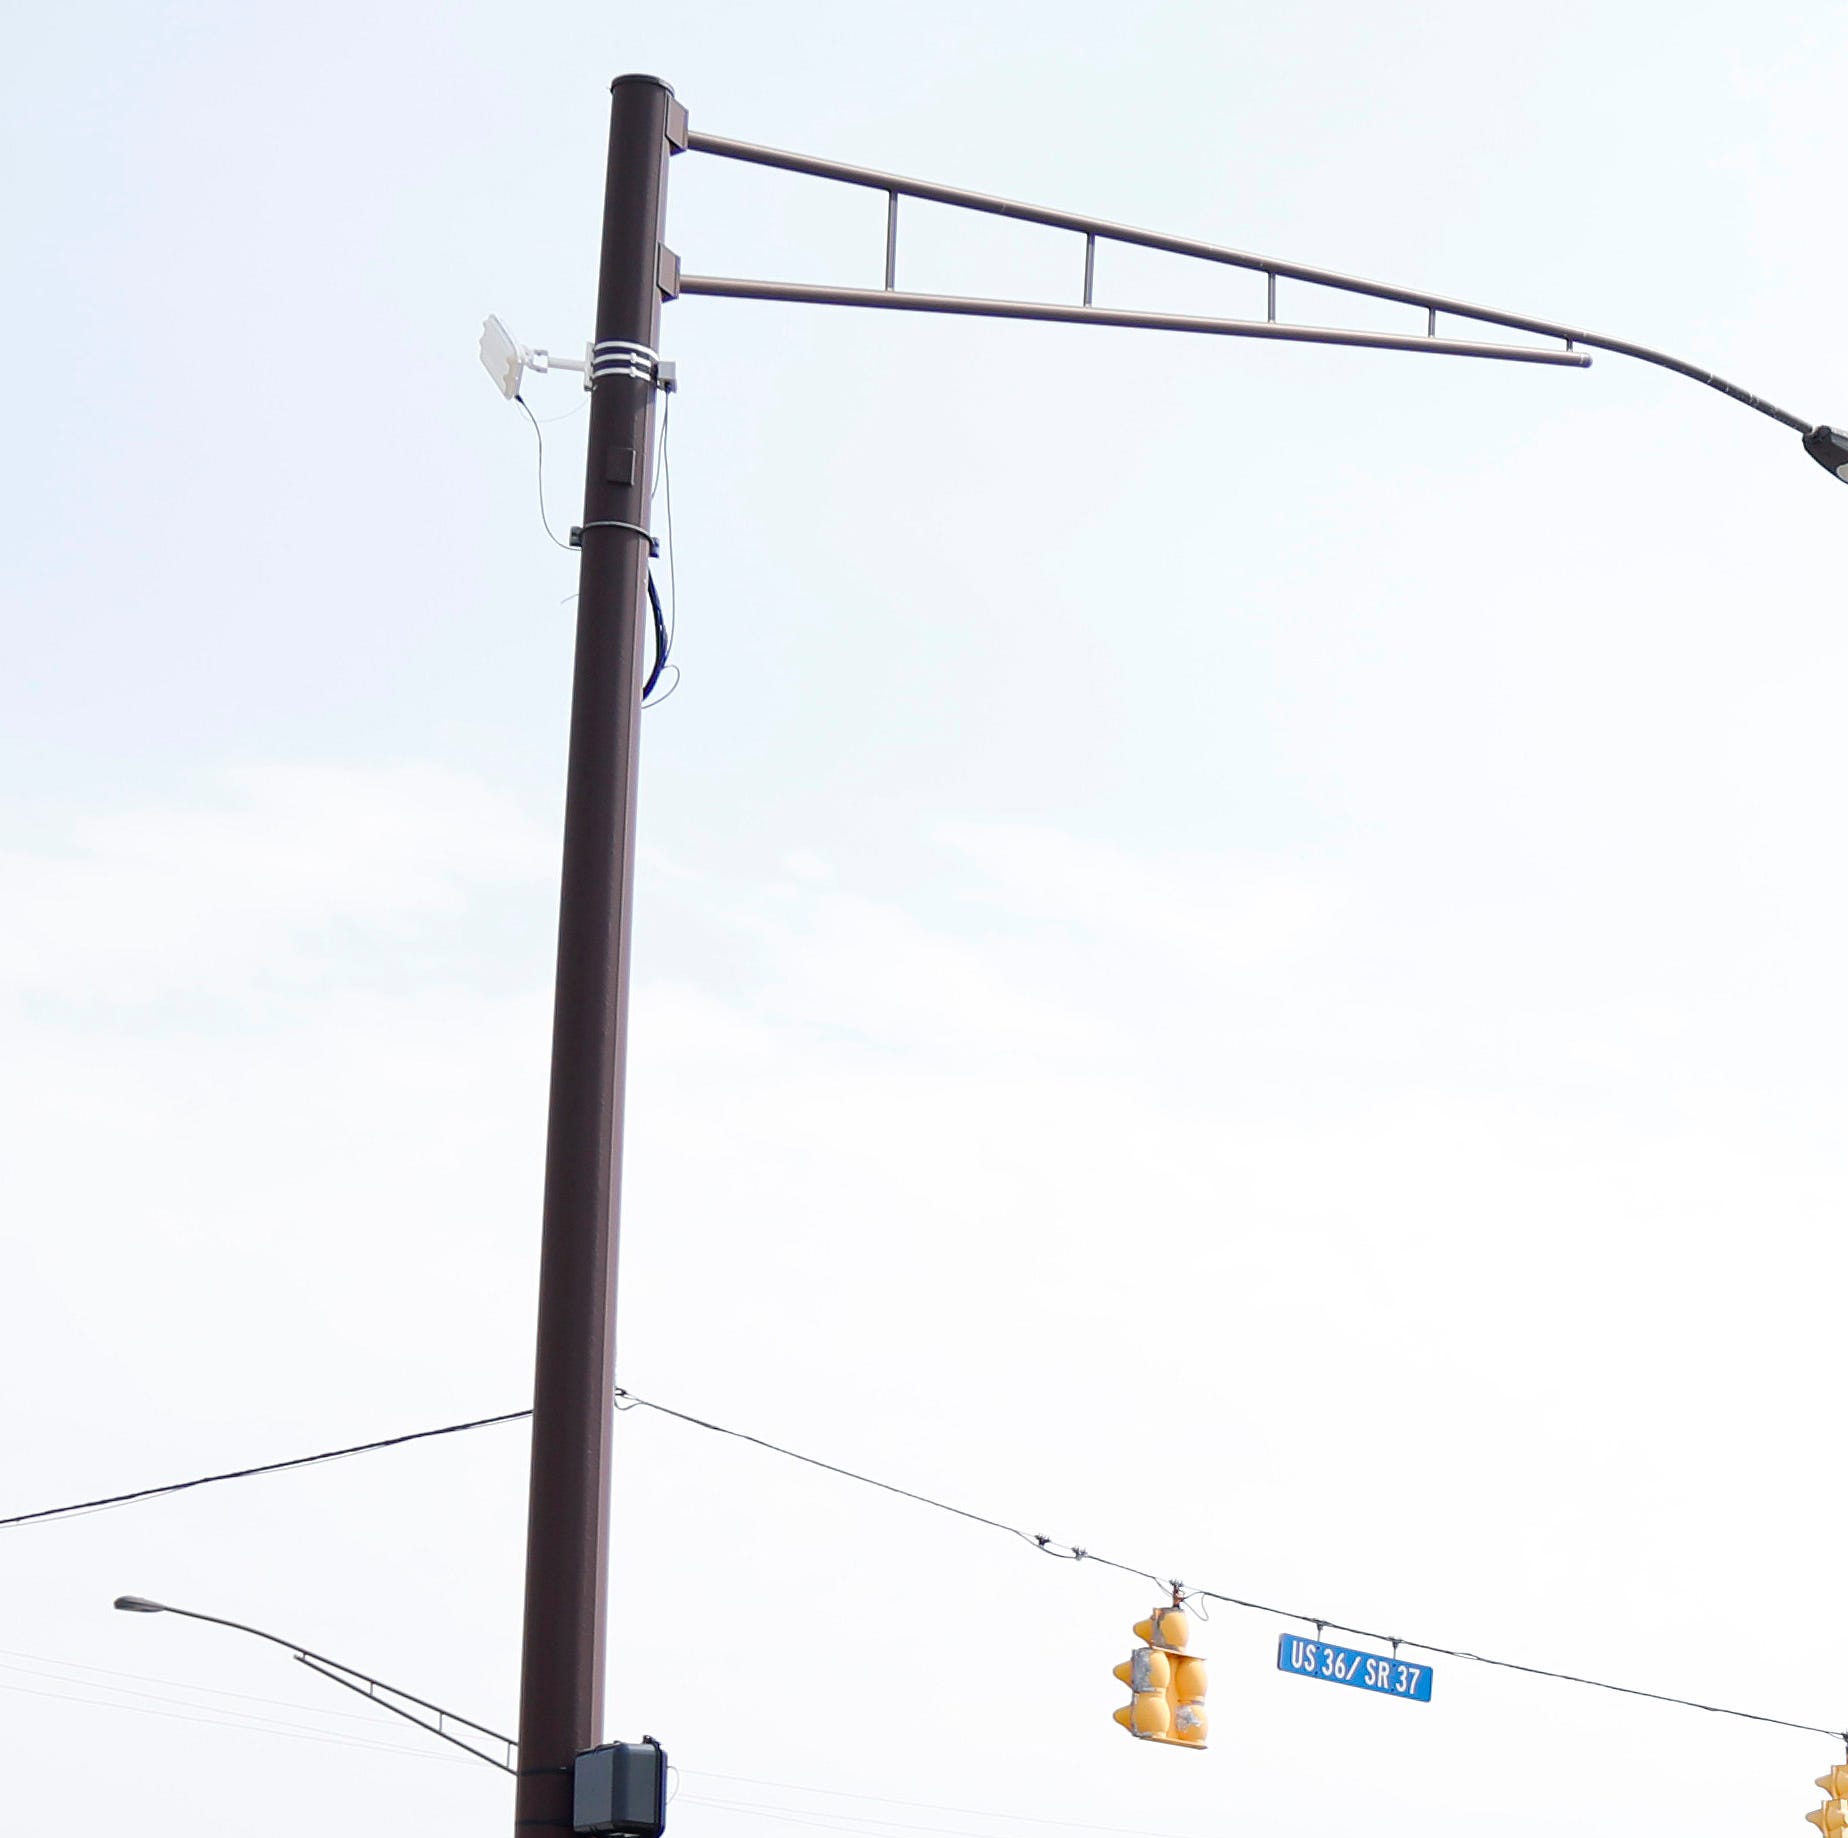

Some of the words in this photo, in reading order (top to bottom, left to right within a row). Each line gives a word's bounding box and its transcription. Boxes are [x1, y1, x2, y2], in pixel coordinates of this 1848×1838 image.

[1291, 1640, 1317, 1673] US
[1364, 1658, 1391, 1689] SR
[1395, 1665, 1421, 1694] 37
